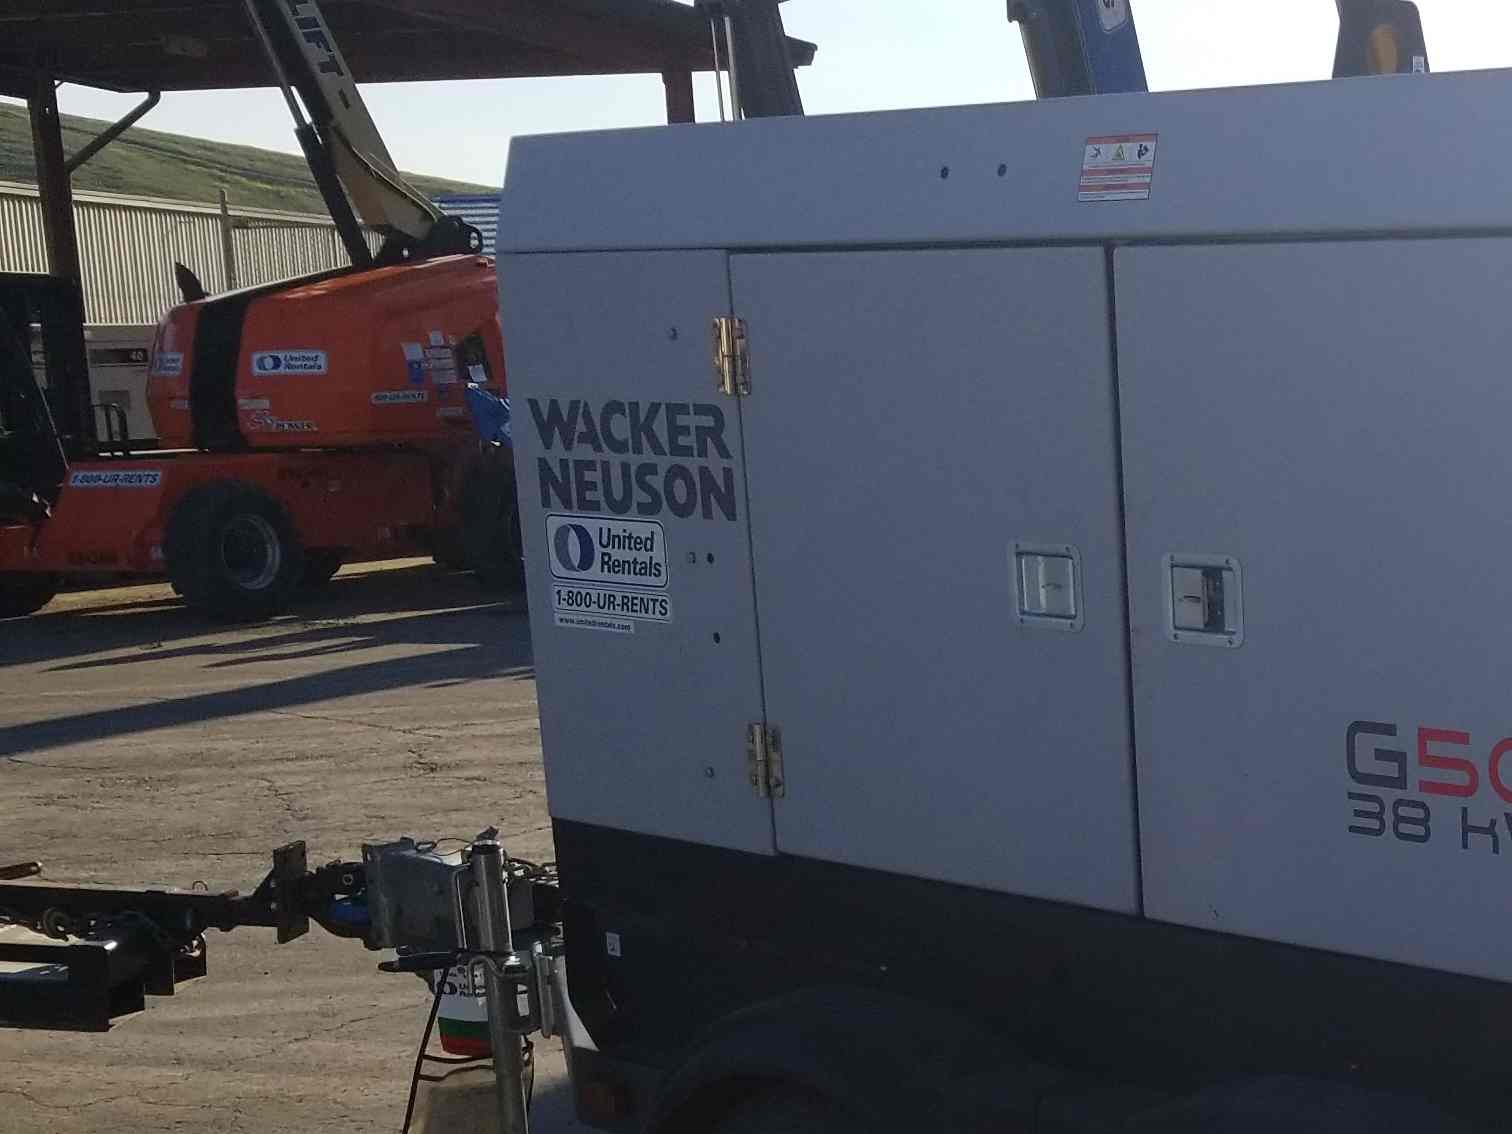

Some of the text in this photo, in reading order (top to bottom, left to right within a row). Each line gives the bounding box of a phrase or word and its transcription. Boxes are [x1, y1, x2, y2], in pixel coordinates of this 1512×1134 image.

[283, 352, 319, 363] United
[527, 397, 733, 460] WACKER
[72, 473, 160, 485] 1-800-UR-RENTS
[537, 457, 737, 522] NEUSON
[598, 527, 655, 553] United
[599, 552, 662, 578] Rentals
[556, 589, 669, 617] 1-800-UR-RENTS
[1346, 791, 1431, 843] 38
